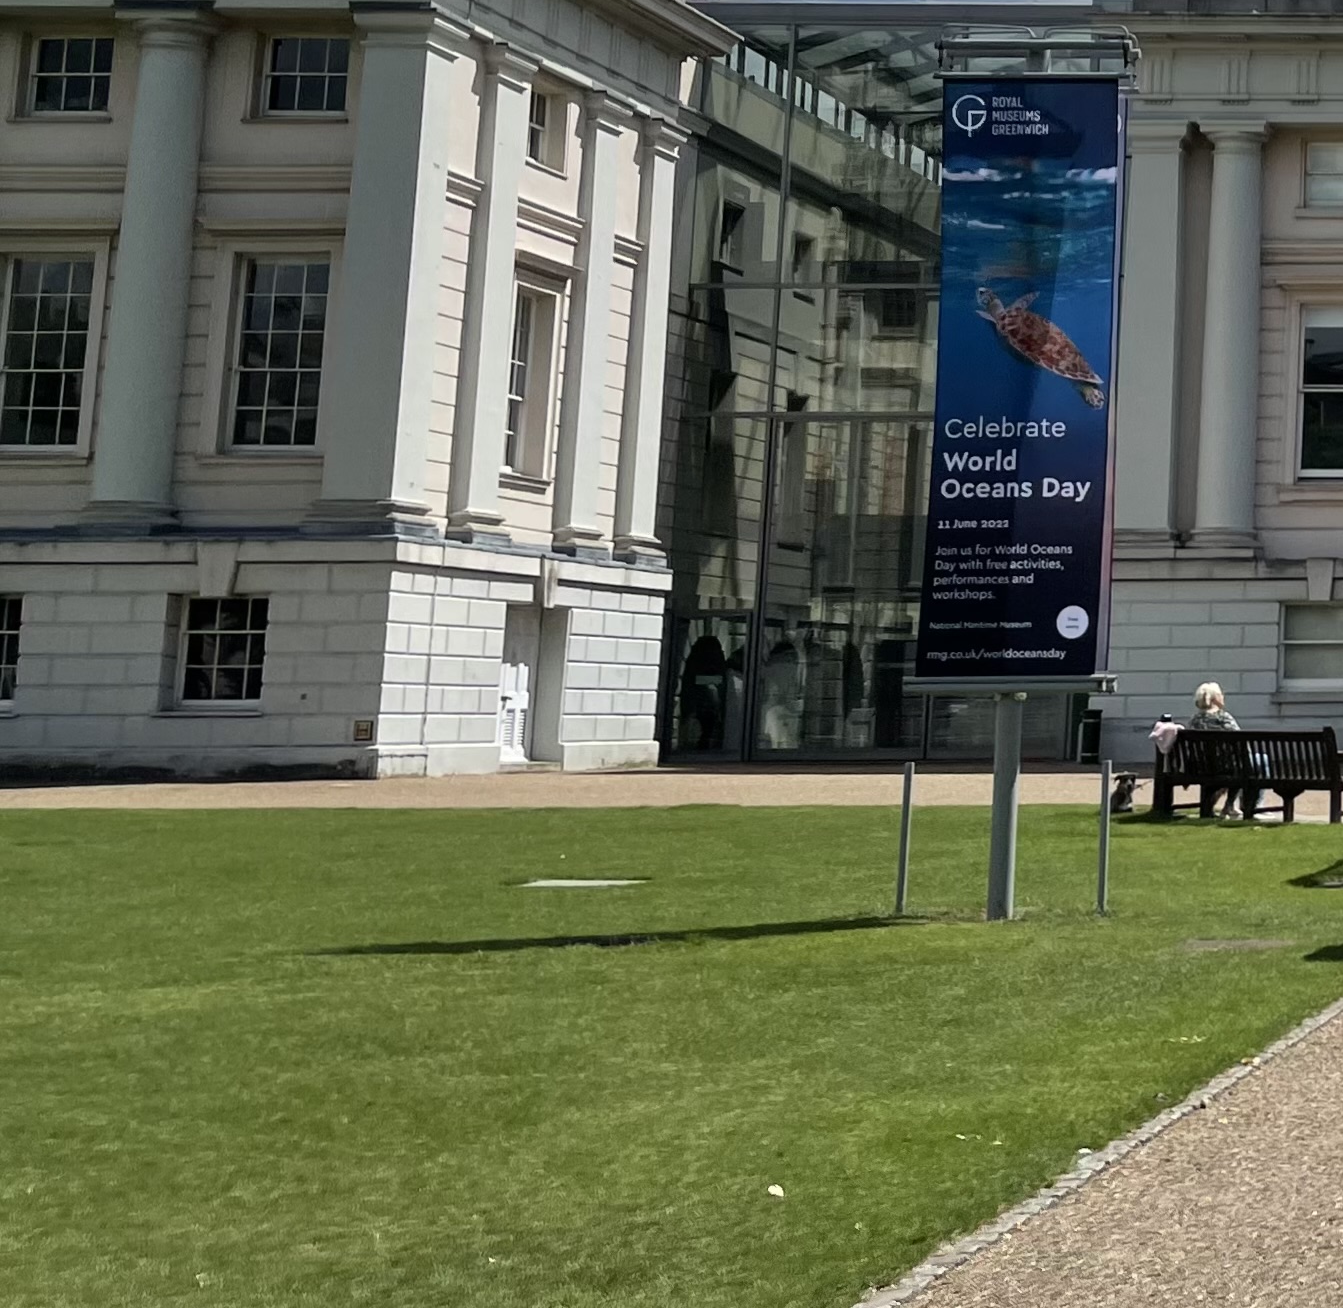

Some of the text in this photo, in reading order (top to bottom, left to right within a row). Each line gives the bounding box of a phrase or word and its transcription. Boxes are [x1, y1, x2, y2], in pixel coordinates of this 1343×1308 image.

[991, 96, 1024, 108] ROYAL
[991, 110, 1041, 122] MUSEUMS
[991, 123, 1049, 136] GREENWICH
[944, 415, 1067, 439] Celebrate
[943, 448, 1018, 472] World
[940, 477, 1092, 502] Oceans Day
[937, 520, 951, 529] 11
[952, 519, 978, 529] June
[935, 543, 1073, 556] Join us for World Oceans
[934, 558, 1065, 572] Day with free activities,
[933, 573, 1034, 586] performances and
[932, 589, 996, 601] workshops.
